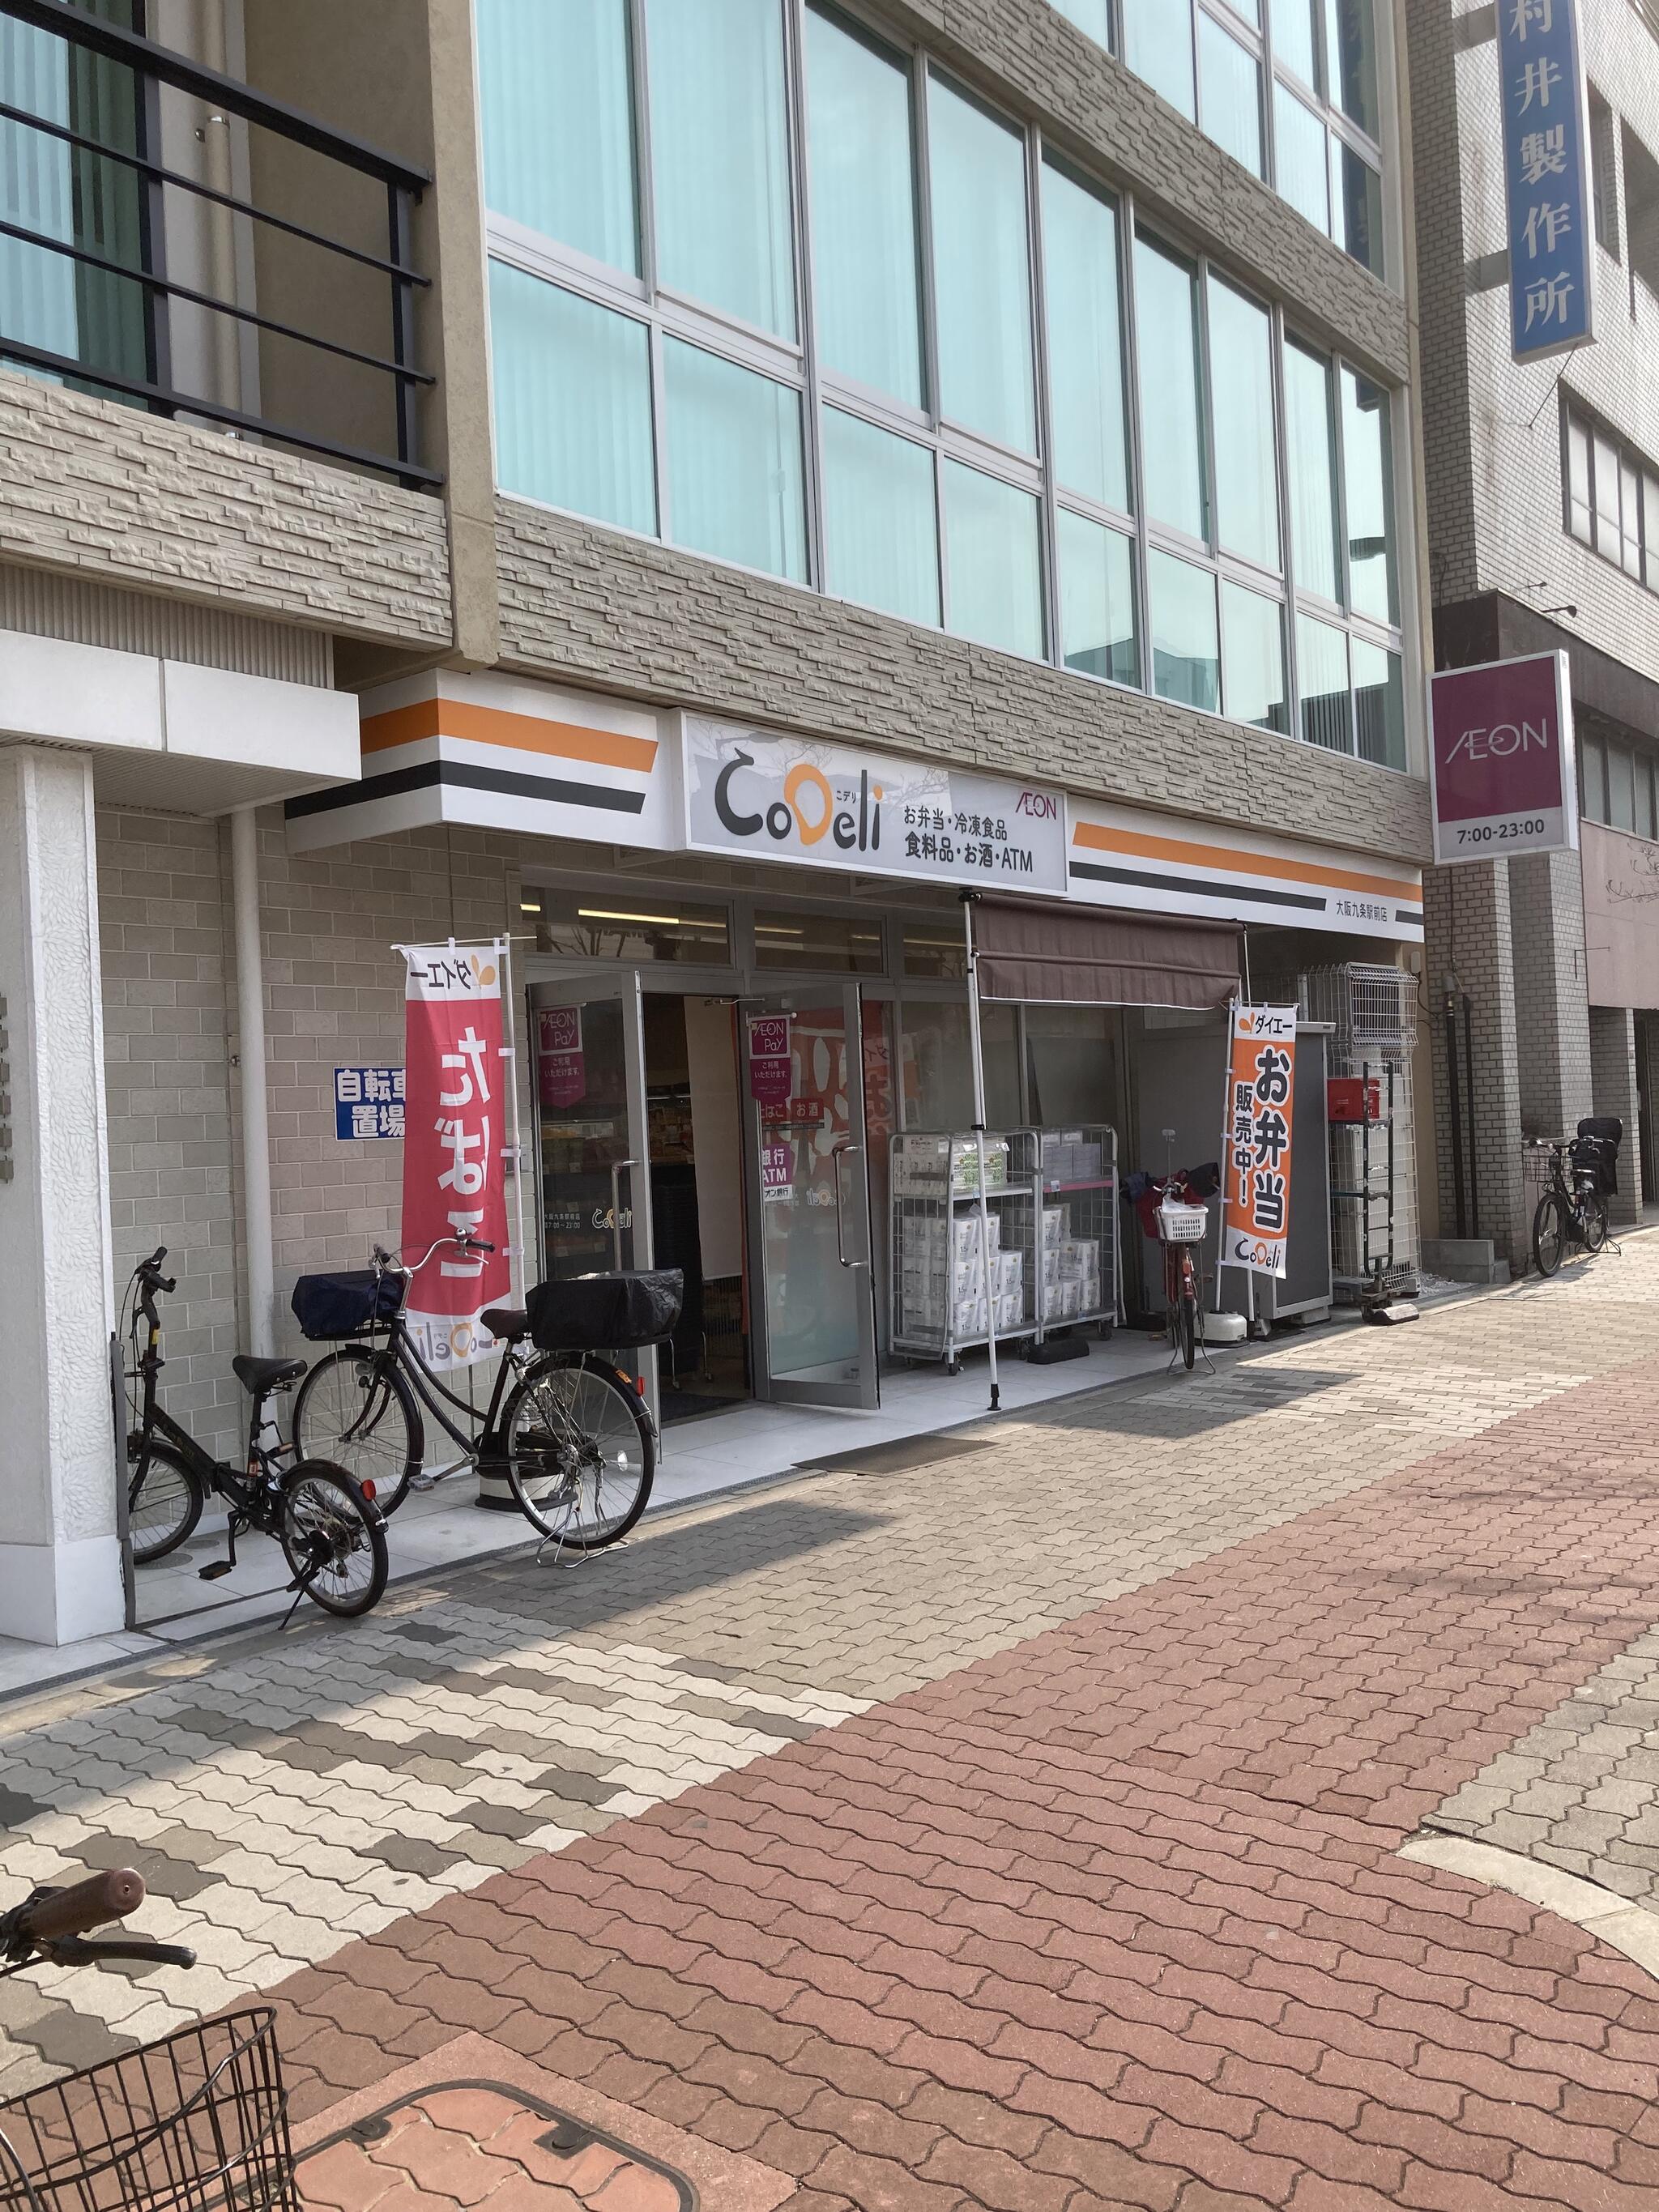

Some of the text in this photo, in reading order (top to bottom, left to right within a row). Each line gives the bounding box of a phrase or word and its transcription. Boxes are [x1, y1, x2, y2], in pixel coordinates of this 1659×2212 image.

[1510, 0, 1576, 334] 村井製作所
[714, 747, 883, 851] CoDeli
[836, 790, 856, 803] こデリ
[904, 805, 1007, 841] お弁当・冷凍食品
[1457, 819, 1545, 844] 7:00-23:00
[905, 831, 1033, 872] 食料品・お酒・ATM
[1336, 899, 1388, 922] 大阪九条駅前店
[1255, 1014, 1293, 1035] ダイエー
[554, 1029, 575, 1046] Pay
[765, 1038, 784, 1051] Pay
[352, 1104, 406, 1138] 置場
[796, 1102, 818, 1117] お酒
[1254, 1047, 1290, 1230] お弁当
[762, 1149, 785, 1166] 銀行
[763, 1167, 787, 1183] ATM
[1234, 1237, 1281, 1269] CoDeli
